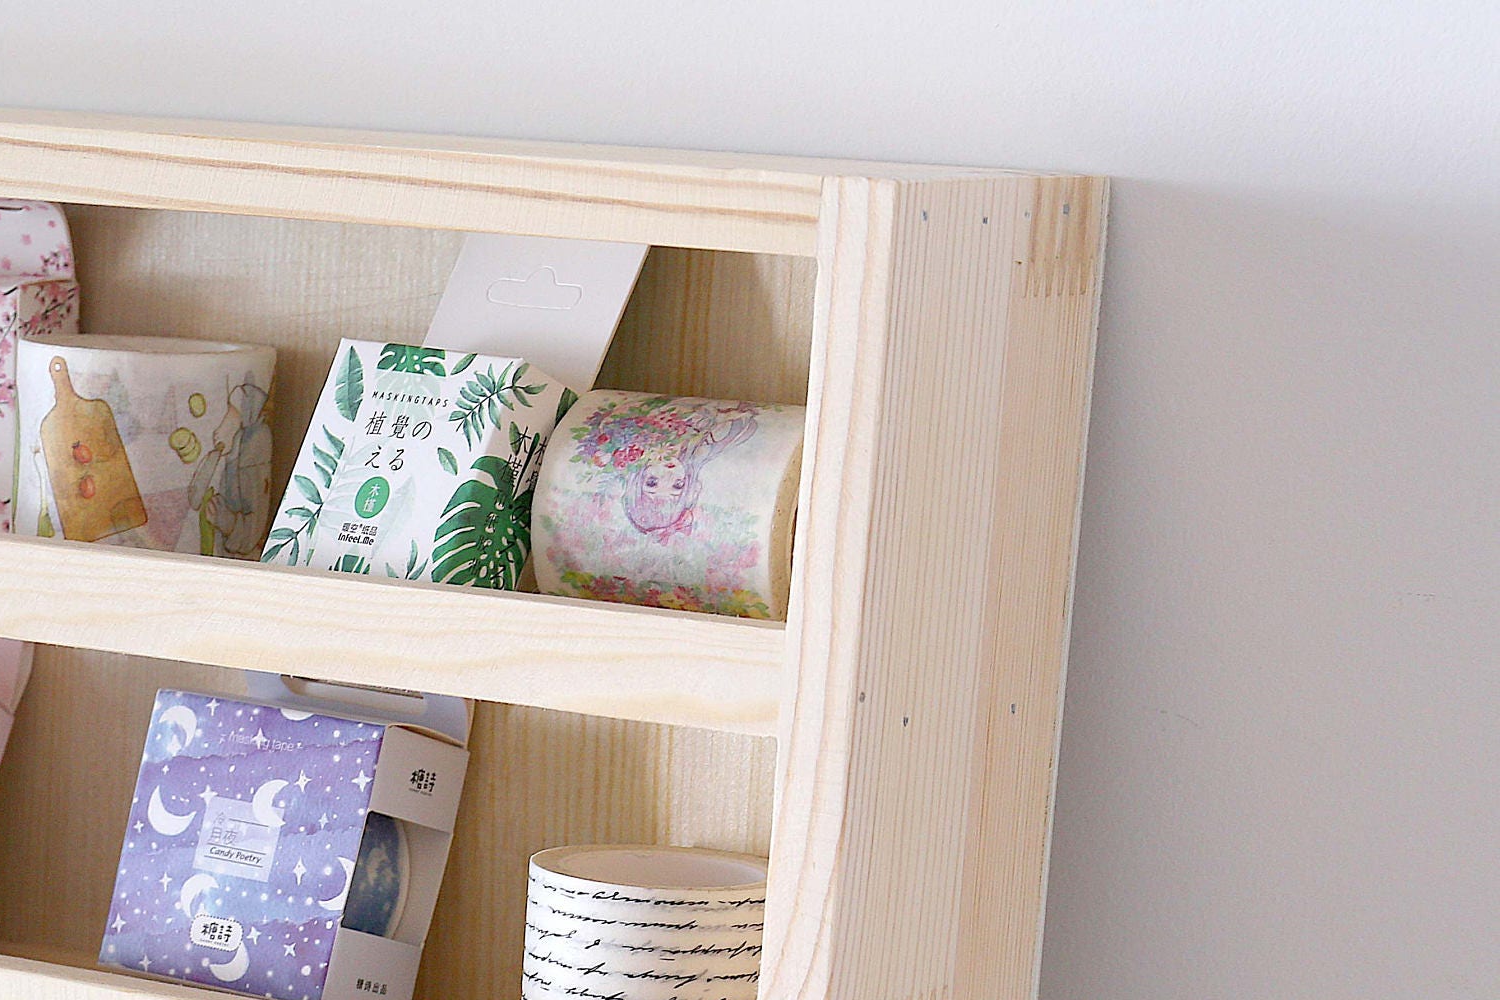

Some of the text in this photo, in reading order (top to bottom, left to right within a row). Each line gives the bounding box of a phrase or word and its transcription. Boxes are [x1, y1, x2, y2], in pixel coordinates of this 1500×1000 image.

[364, 444, 405, 471] える
[209, 846, 262, 864] Candy Poetry
